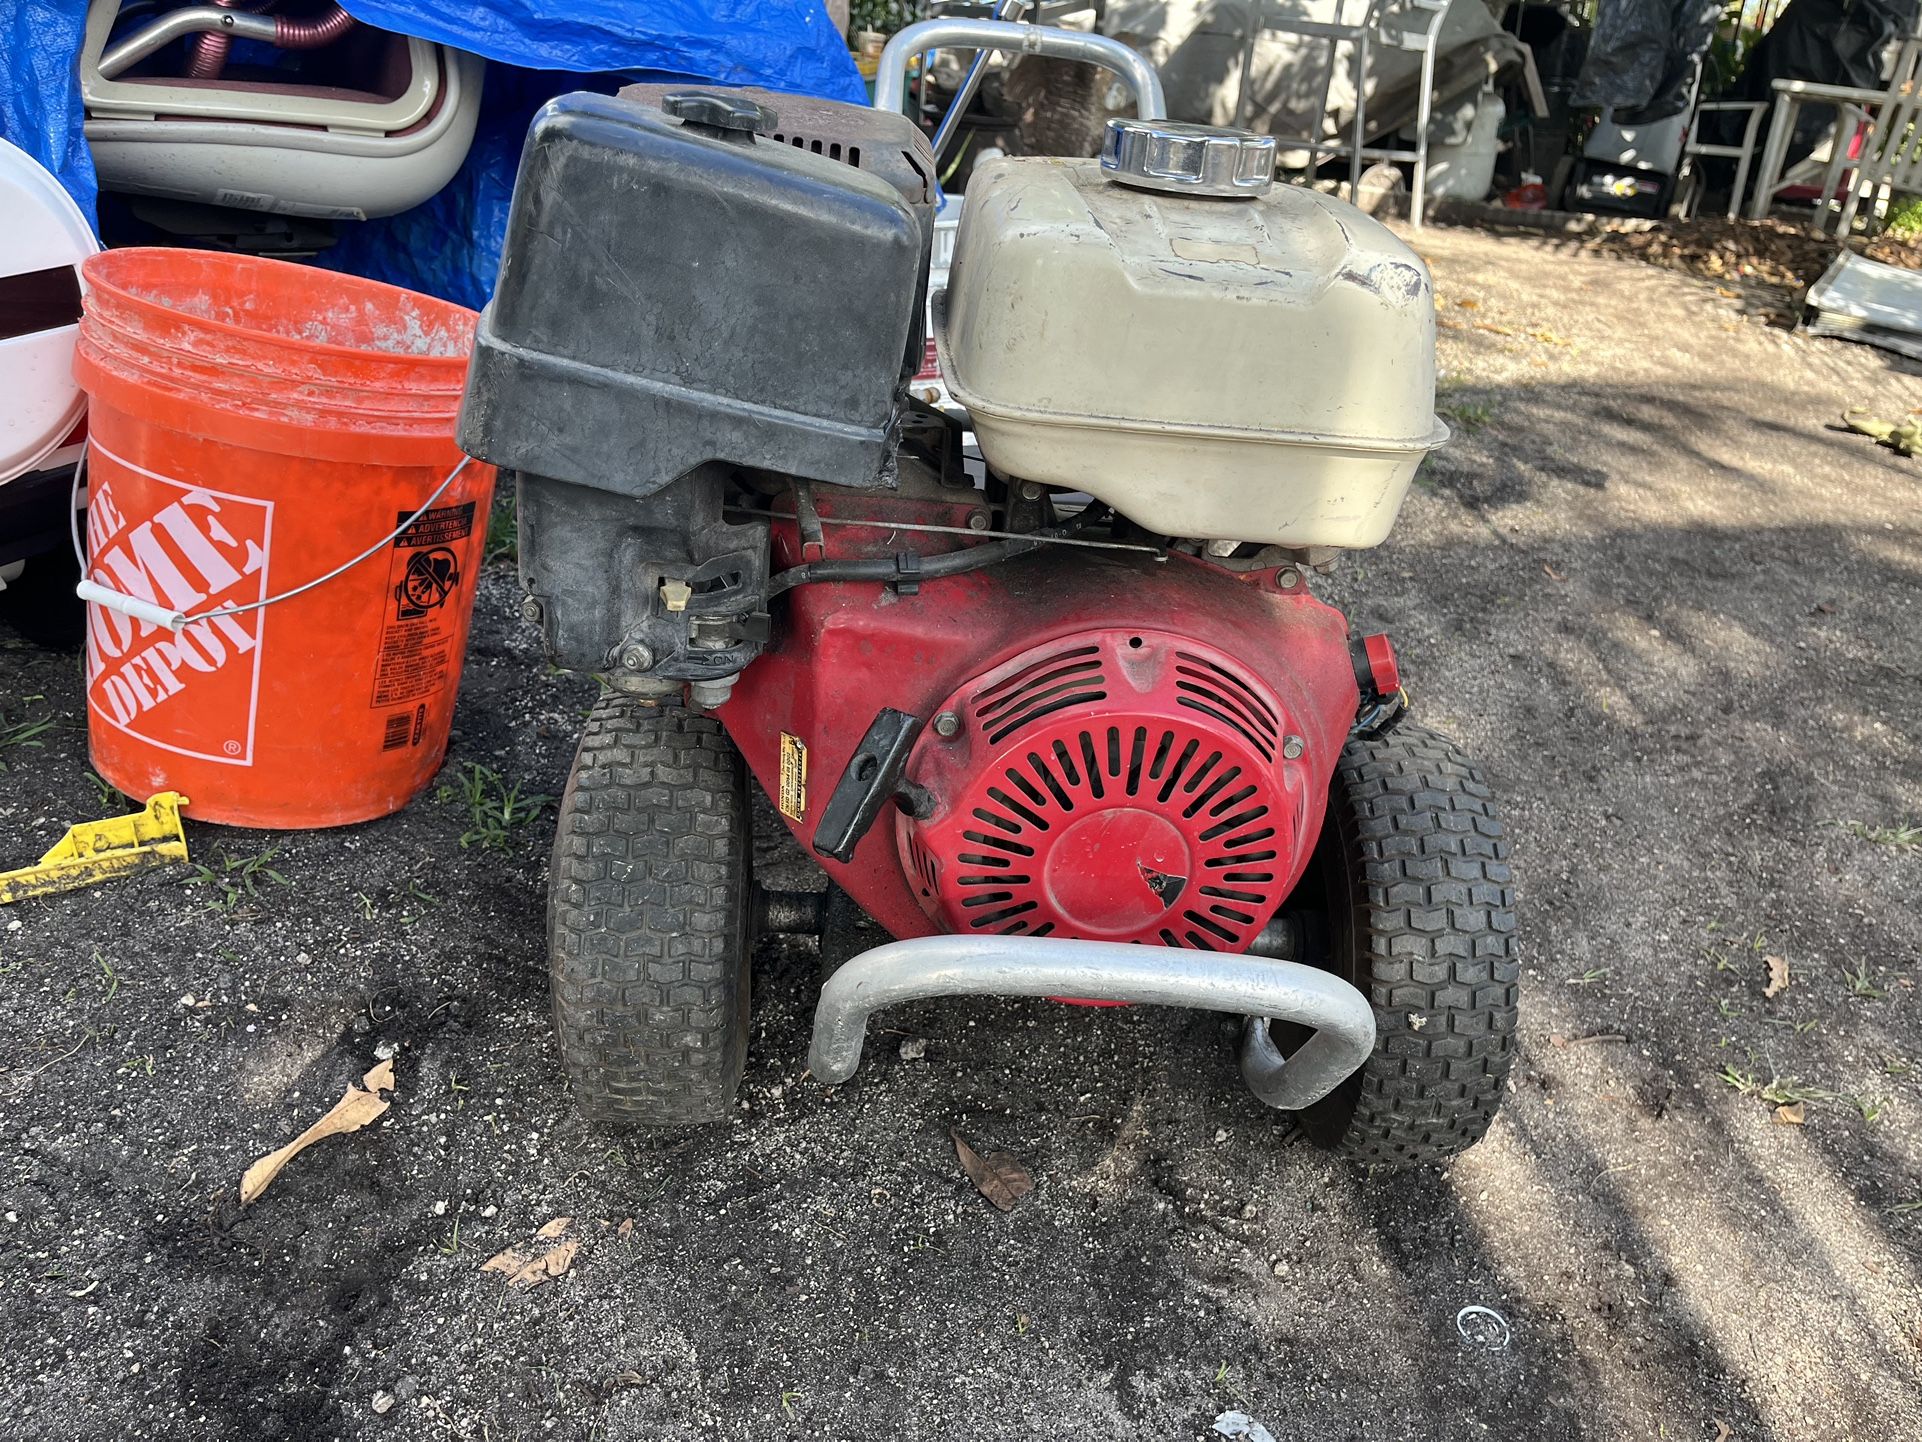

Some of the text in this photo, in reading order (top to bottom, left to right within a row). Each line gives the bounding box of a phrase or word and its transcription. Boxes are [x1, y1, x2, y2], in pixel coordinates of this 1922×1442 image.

[410, 527, 470, 546] AVERTISSEMENT
[102, 600, 257, 727] DEPOT
[713, 654, 734, 665] ON
